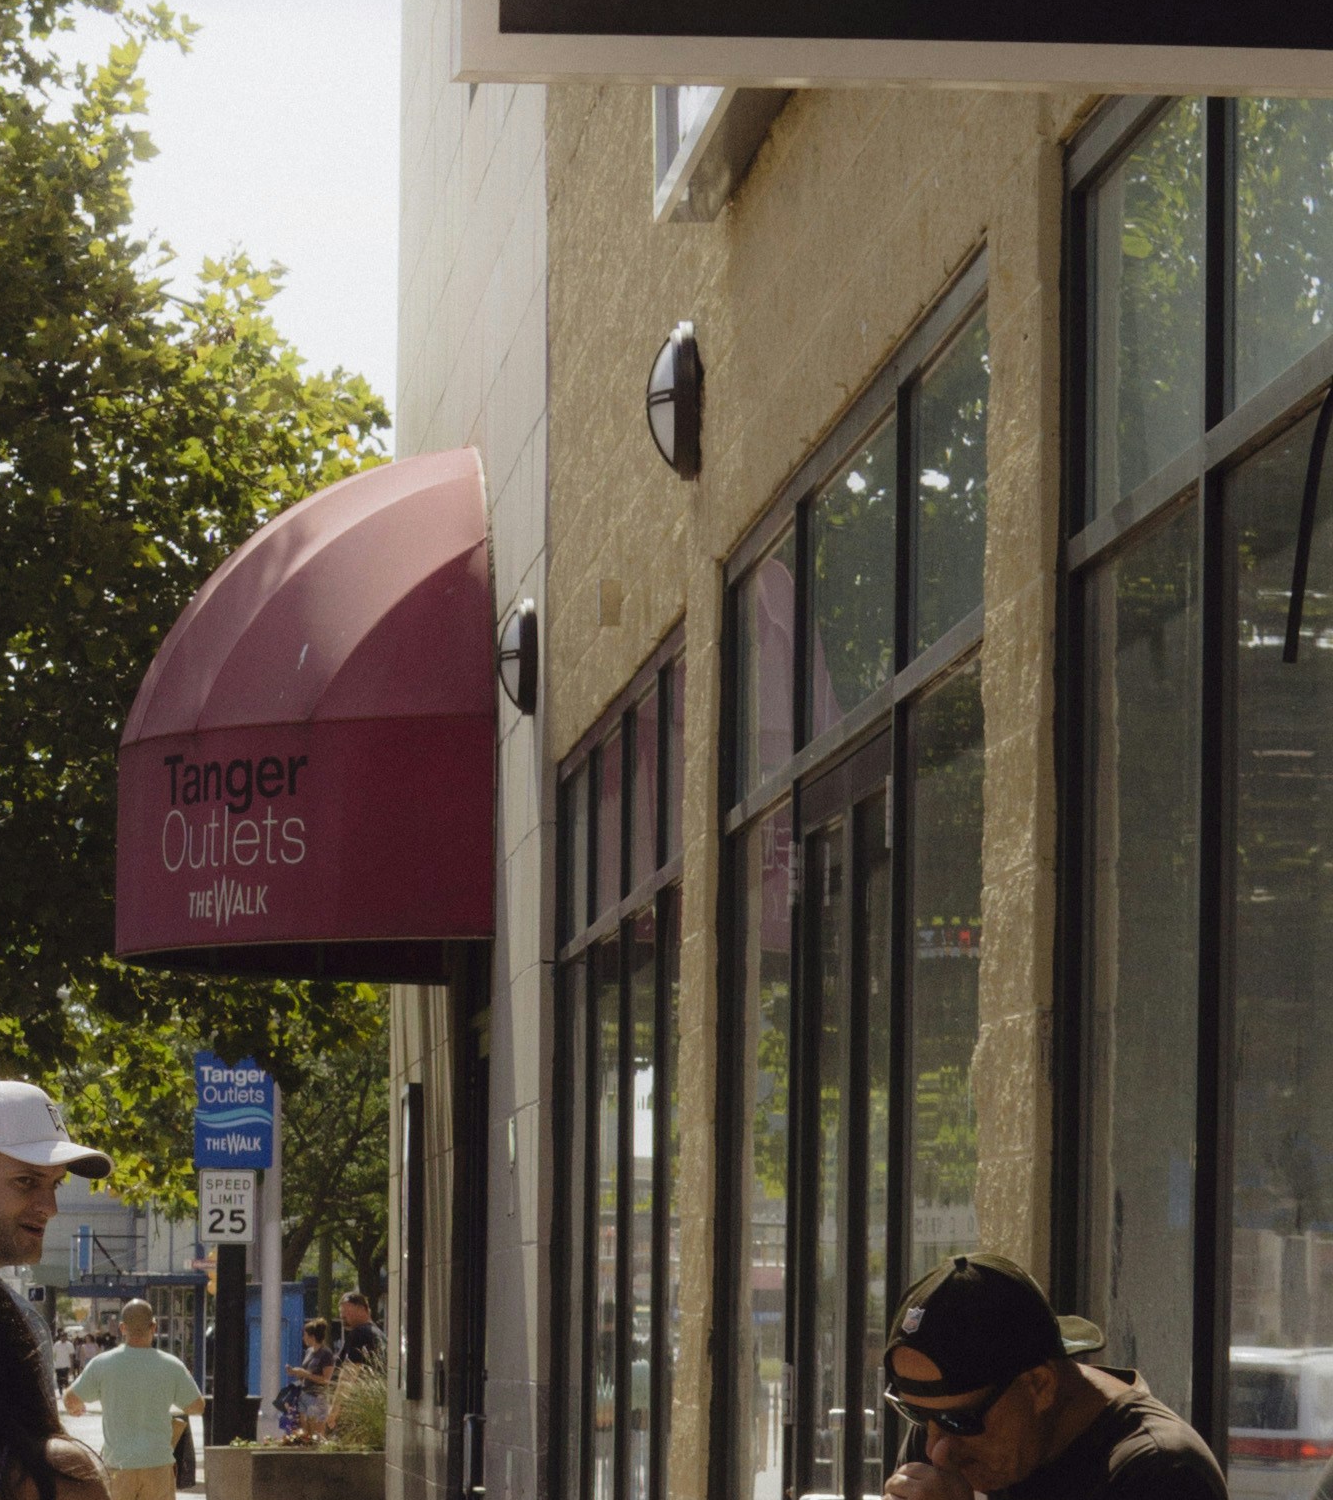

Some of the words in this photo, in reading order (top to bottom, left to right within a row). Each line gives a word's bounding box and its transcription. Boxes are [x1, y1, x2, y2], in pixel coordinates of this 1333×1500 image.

[163, 754, 309, 815] Tanger
[162, 805, 306, 873] Outlets
[200, 1066, 267, 1087] Tanger
[203, 1085, 266, 1104] Outlets
[205, 1178, 251, 1191] SPEED
[210, 1193, 245, 1205] LIMIT
[208, 1208, 247, 1234] 25
